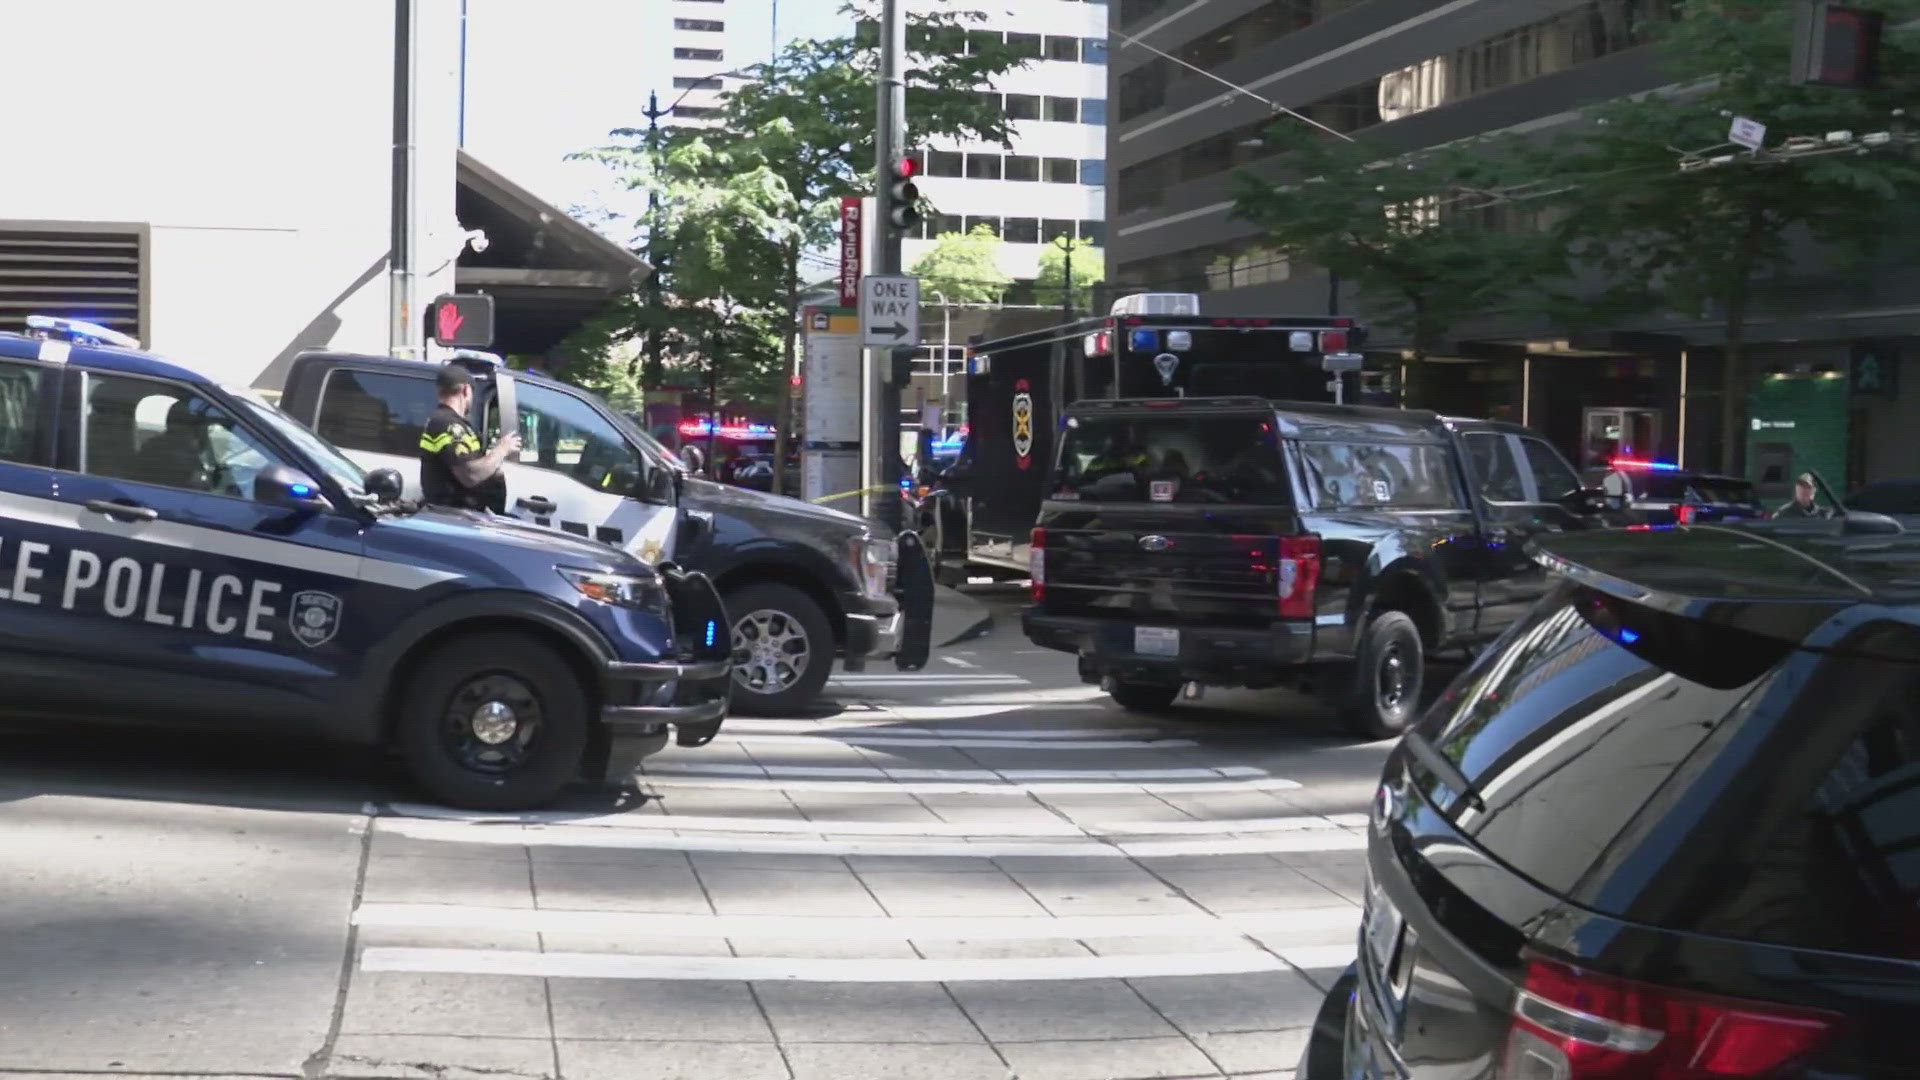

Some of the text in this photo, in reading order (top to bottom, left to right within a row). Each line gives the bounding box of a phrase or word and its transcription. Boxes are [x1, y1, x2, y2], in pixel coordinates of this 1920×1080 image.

[844, 206, 859, 298] RAPIDRIDE
[872, 302, 911, 317] WAY
[873, 283, 909, 298] ONE
[62, 549, 283, 642] POLICE
